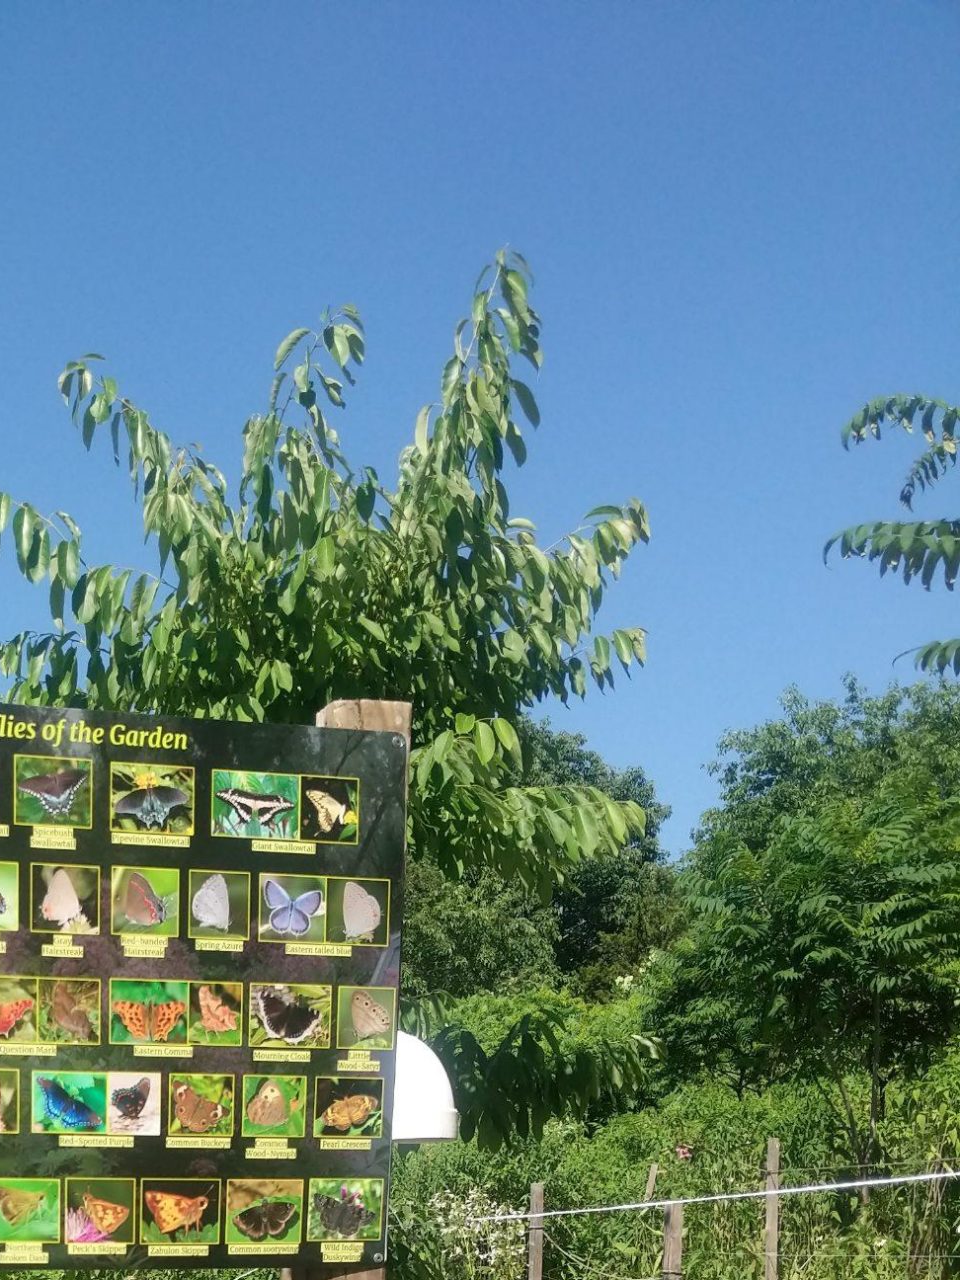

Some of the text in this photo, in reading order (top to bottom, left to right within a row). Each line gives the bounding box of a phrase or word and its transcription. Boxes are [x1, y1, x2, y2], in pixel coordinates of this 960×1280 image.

[41, 718, 66, 746] of
[70, 720, 103, 744] the
[109, 724, 188, 750] Garden
[33, 827, 73, 838] Spicebush
[31, 838, 75, 848] Swallowtail
[112, 834, 190, 847] Pipevine Swallowtail
[252, 841, 315, 853] Giant Swallowtail
[54, 936, 72, 946] Gray
[196, 940, 242, 951] Spring Azure
[42, 946, 83, 956] Hairstreak
[125, 947, 164, 956] Hairstreak
[286, 945, 352, 956] Eastern tailed blue
[0, 1045, 56, 1055] Question Mark
[134, 1046, 193, 1056] Eastern Comma
[254, 1051, 289, 1061] Mourning
[109, 1138, 133, 1148] Purple
[166, 1138, 199, 1147] Common
[322, 1141, 371, 1150] Pearl Crescent
[72, 1244, 126, 1255] Peck's Skipper
[180, 1246, 208, 1256] Skipper
[229, 1245, 260, 1254] Common
